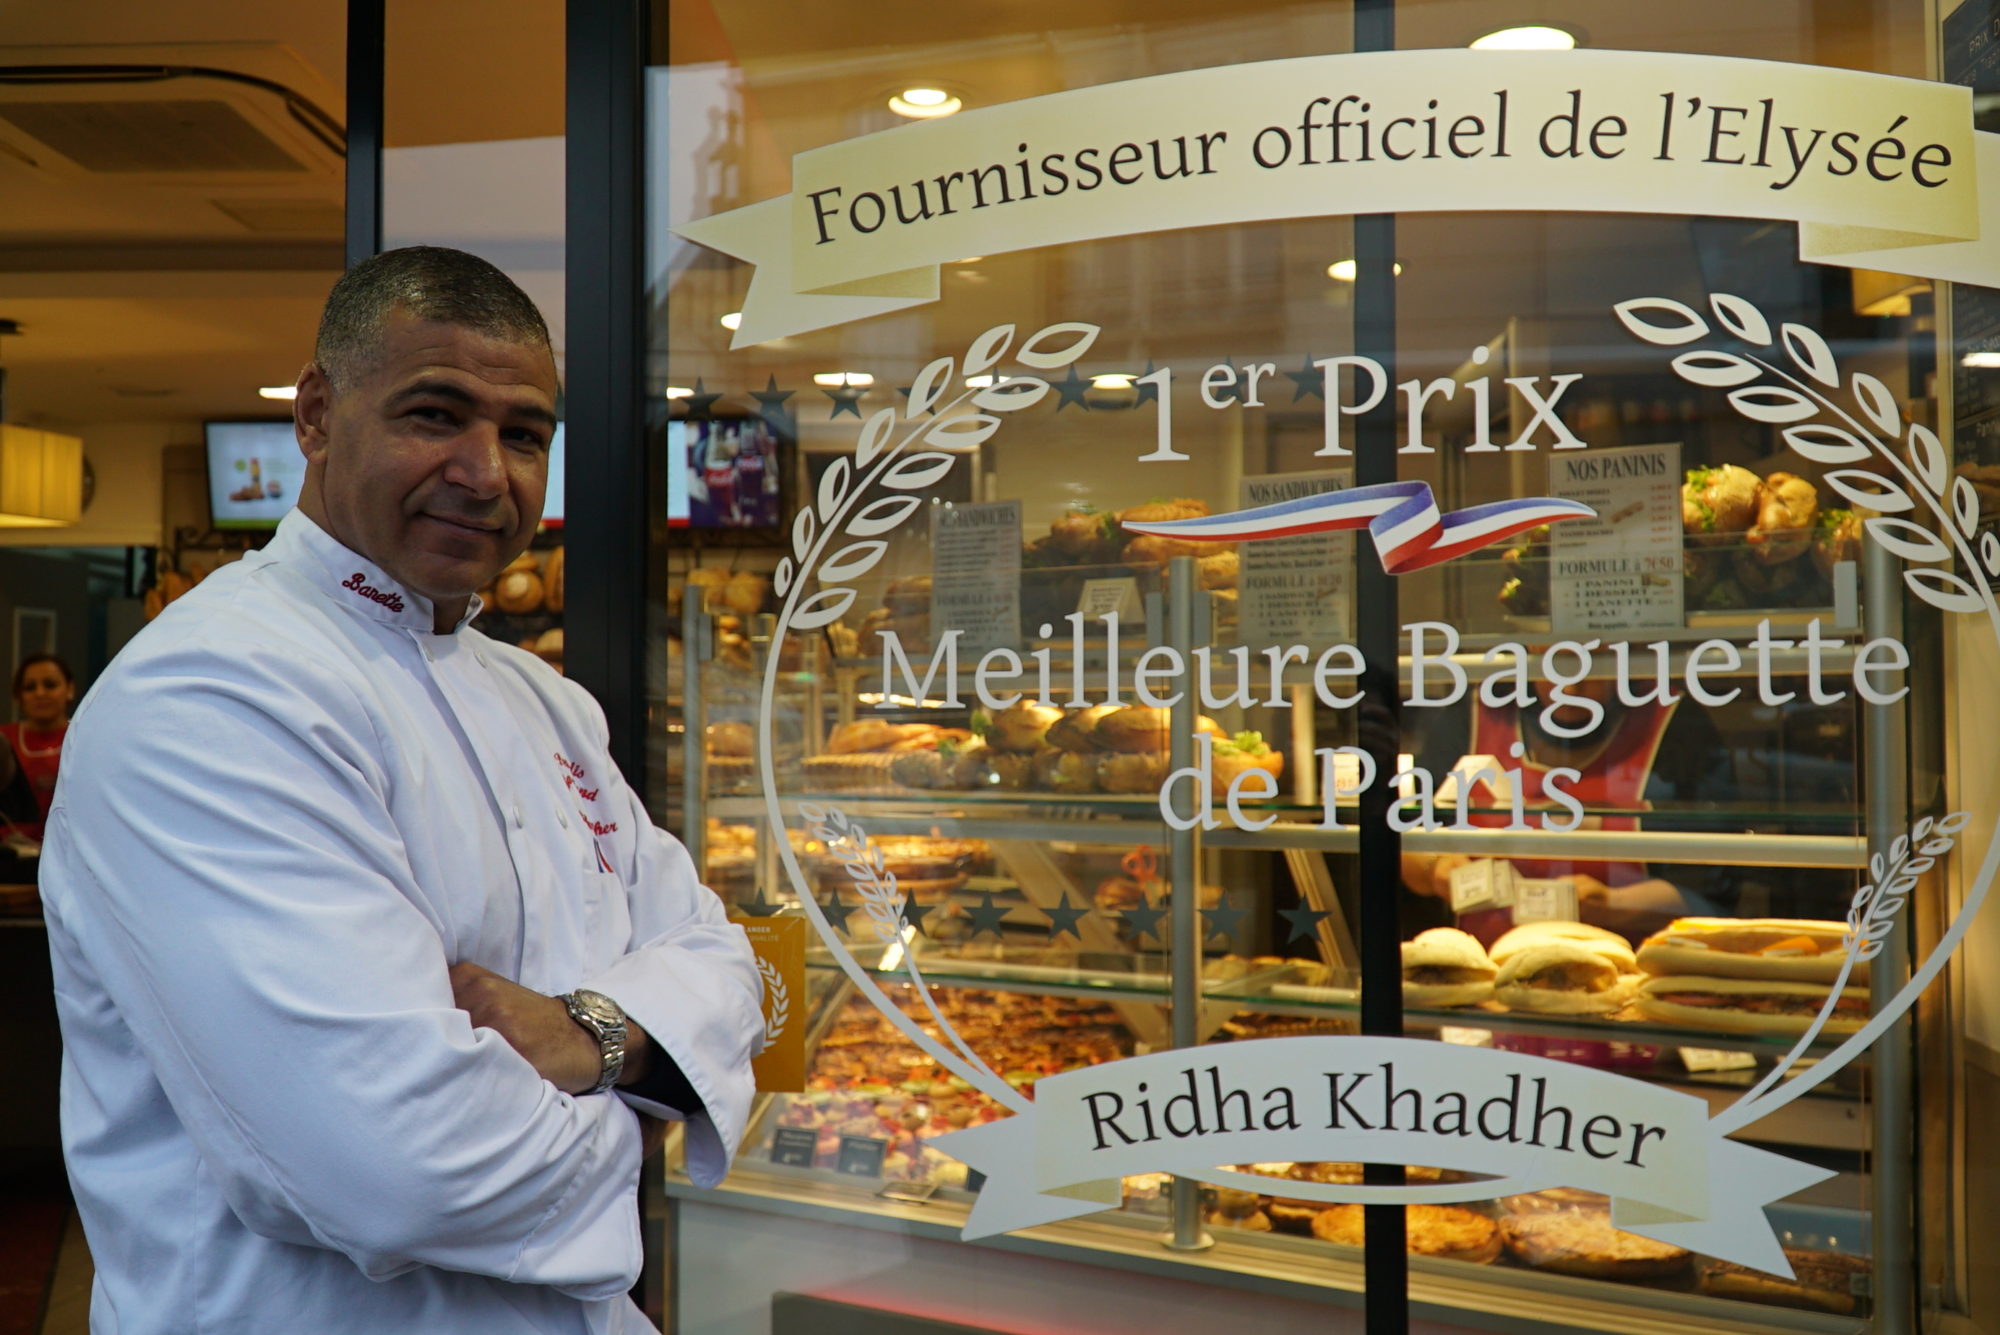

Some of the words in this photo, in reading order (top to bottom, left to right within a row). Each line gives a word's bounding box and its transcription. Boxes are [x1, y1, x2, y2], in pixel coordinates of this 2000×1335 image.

[805, 131, 1227, 246] Fournisseur
[1252, 90, 1510, 169] officiel
[1539, 89, 1627, 159] de
[1137, 362, 1276, 462] 1er
[1312, 345, 1587, 457] Prix
[1566, 457, 1599, 482] NOS
[1602, 453, 1666, 479] PANINIS
[341, 572, 405, 613] Banette
[874, 610, 1367, 710] Meilleure
[1399, 617, 1911, 738] Baguette
[1158, 732, 1280, 832] de
[1314, 741, 1585, 834] Paris
[1081, 1065, 1301, 1151] Ridha
[1323, 1062, 1666, 1168] Khadher
